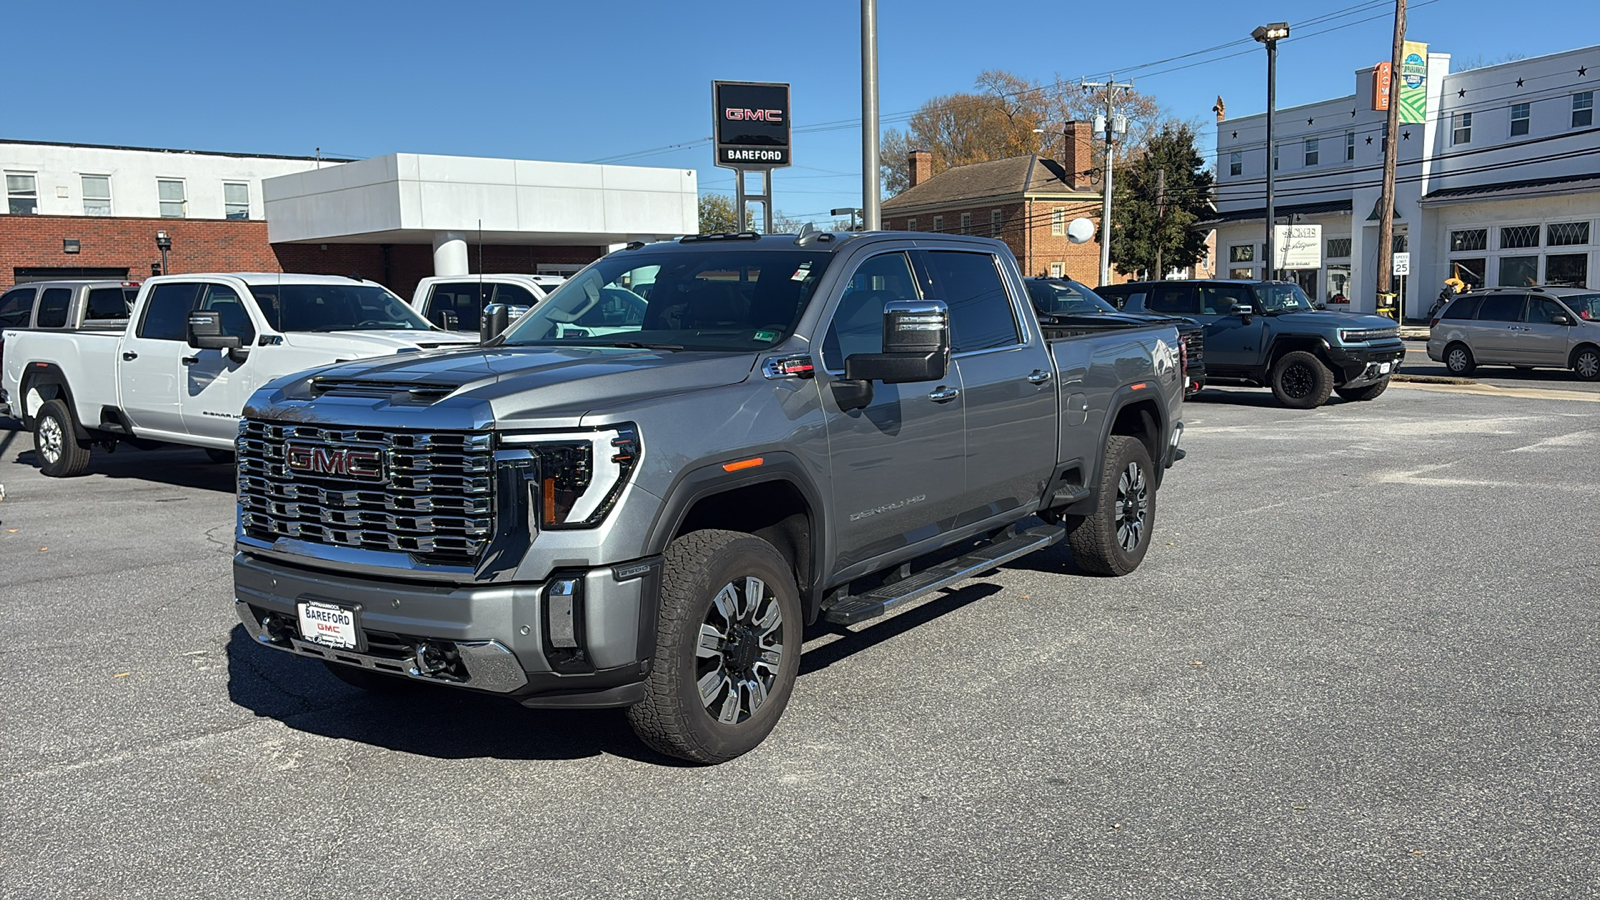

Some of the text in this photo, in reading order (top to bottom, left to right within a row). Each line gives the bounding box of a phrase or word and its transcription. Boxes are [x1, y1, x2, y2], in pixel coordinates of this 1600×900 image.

[1381, 65, 1390, 108] ACME
[726, 107, 782, 122] GMC
[727, 149, 782, 160] BAREFORD
[1395, 263, 1408, 273] 25
[288, 447, 380, 478] GMC
[306, 608, 350, 625] BAREFORD
[317, 623, 341, 634] GMC
